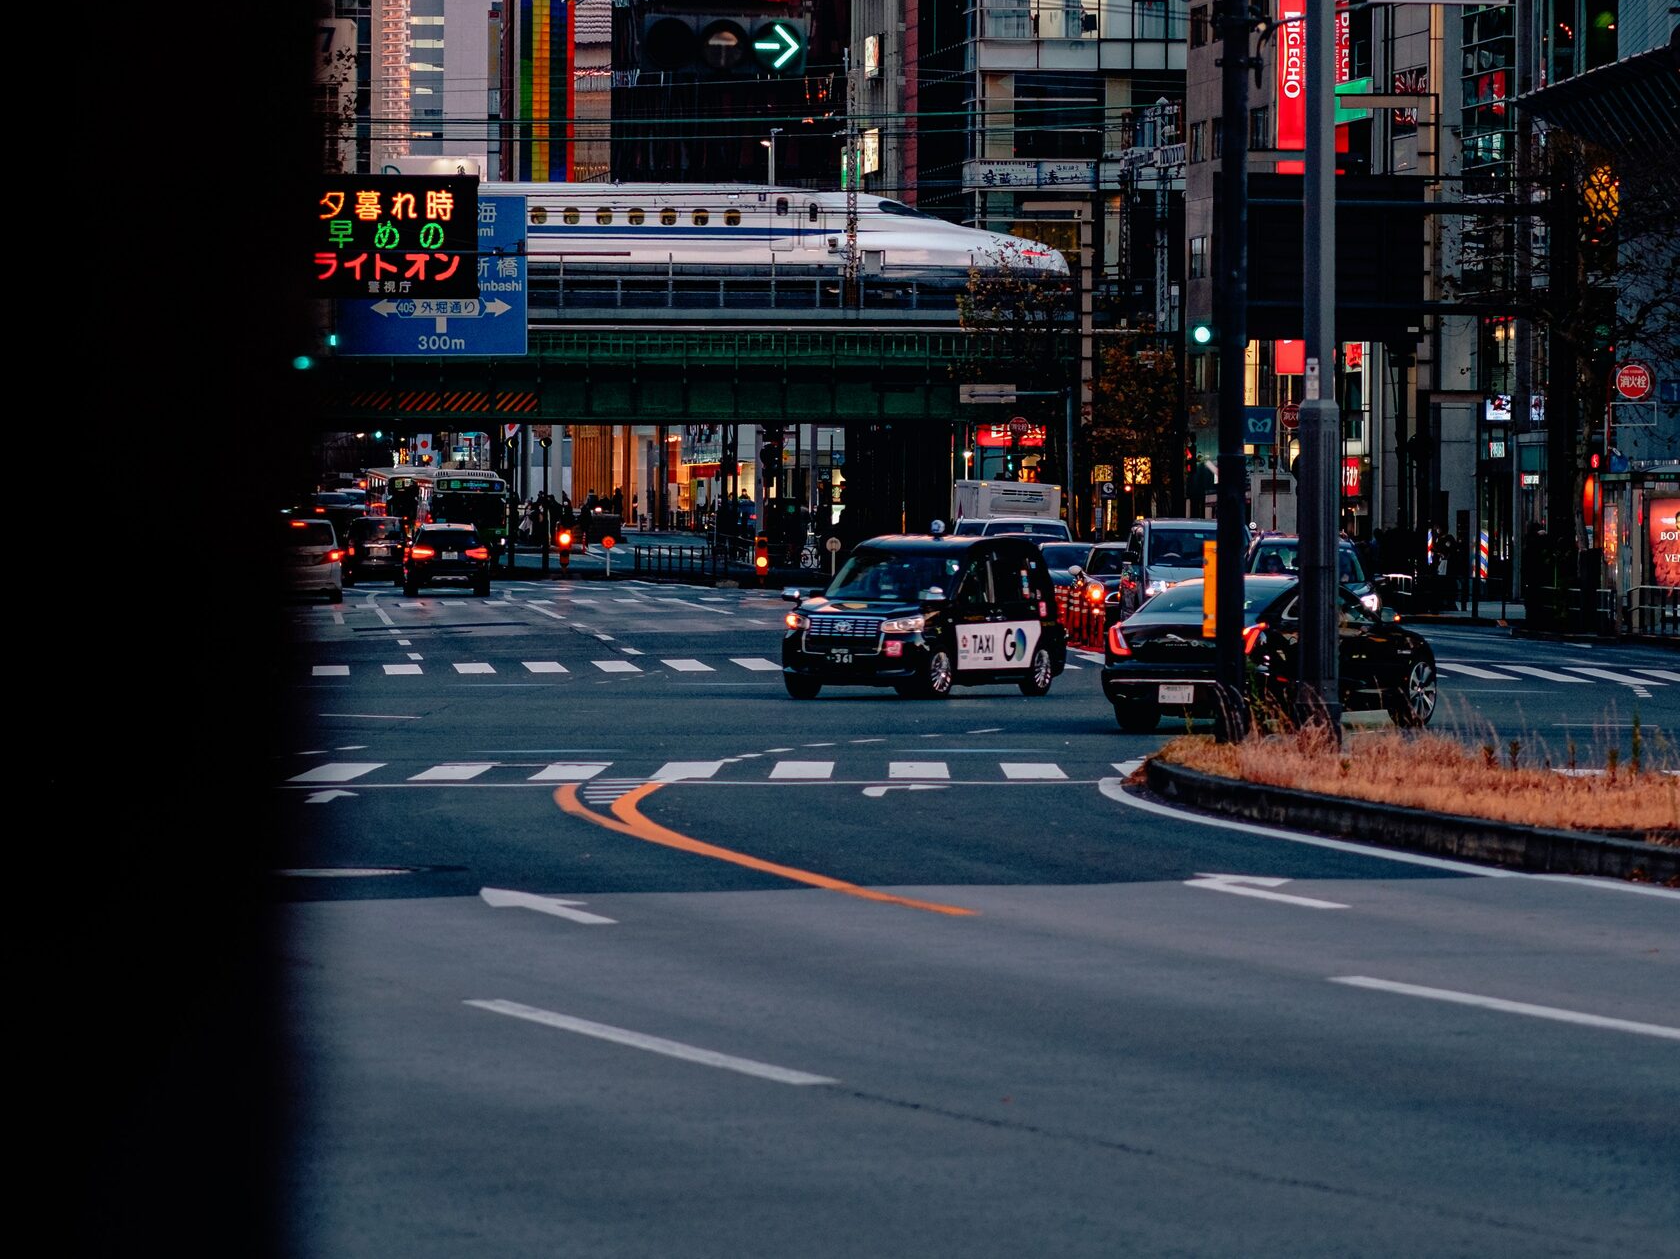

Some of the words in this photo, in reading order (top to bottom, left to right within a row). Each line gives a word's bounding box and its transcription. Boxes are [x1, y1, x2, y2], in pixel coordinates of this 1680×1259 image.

[1284, 11, 1301, 45] BIG
[1284, 48, 1301, 98] ECHO
[319, 190, 454, 221] 夕暮れ時
[328, 220, 445, 249] 早めの
[313, 253, 461, 280] ライトオン
[367, 281, 412, 293] 警視庁
[398, 299, 415, 312] 405
[420, 300, 476, 314] 外堀通り
[417, 335, 466, 350] 300m
[1620, 375, 1648, 388] 消火栓
[972, 634, 995, 654] TAXI
[1003, 627, 1027, 662] GO
